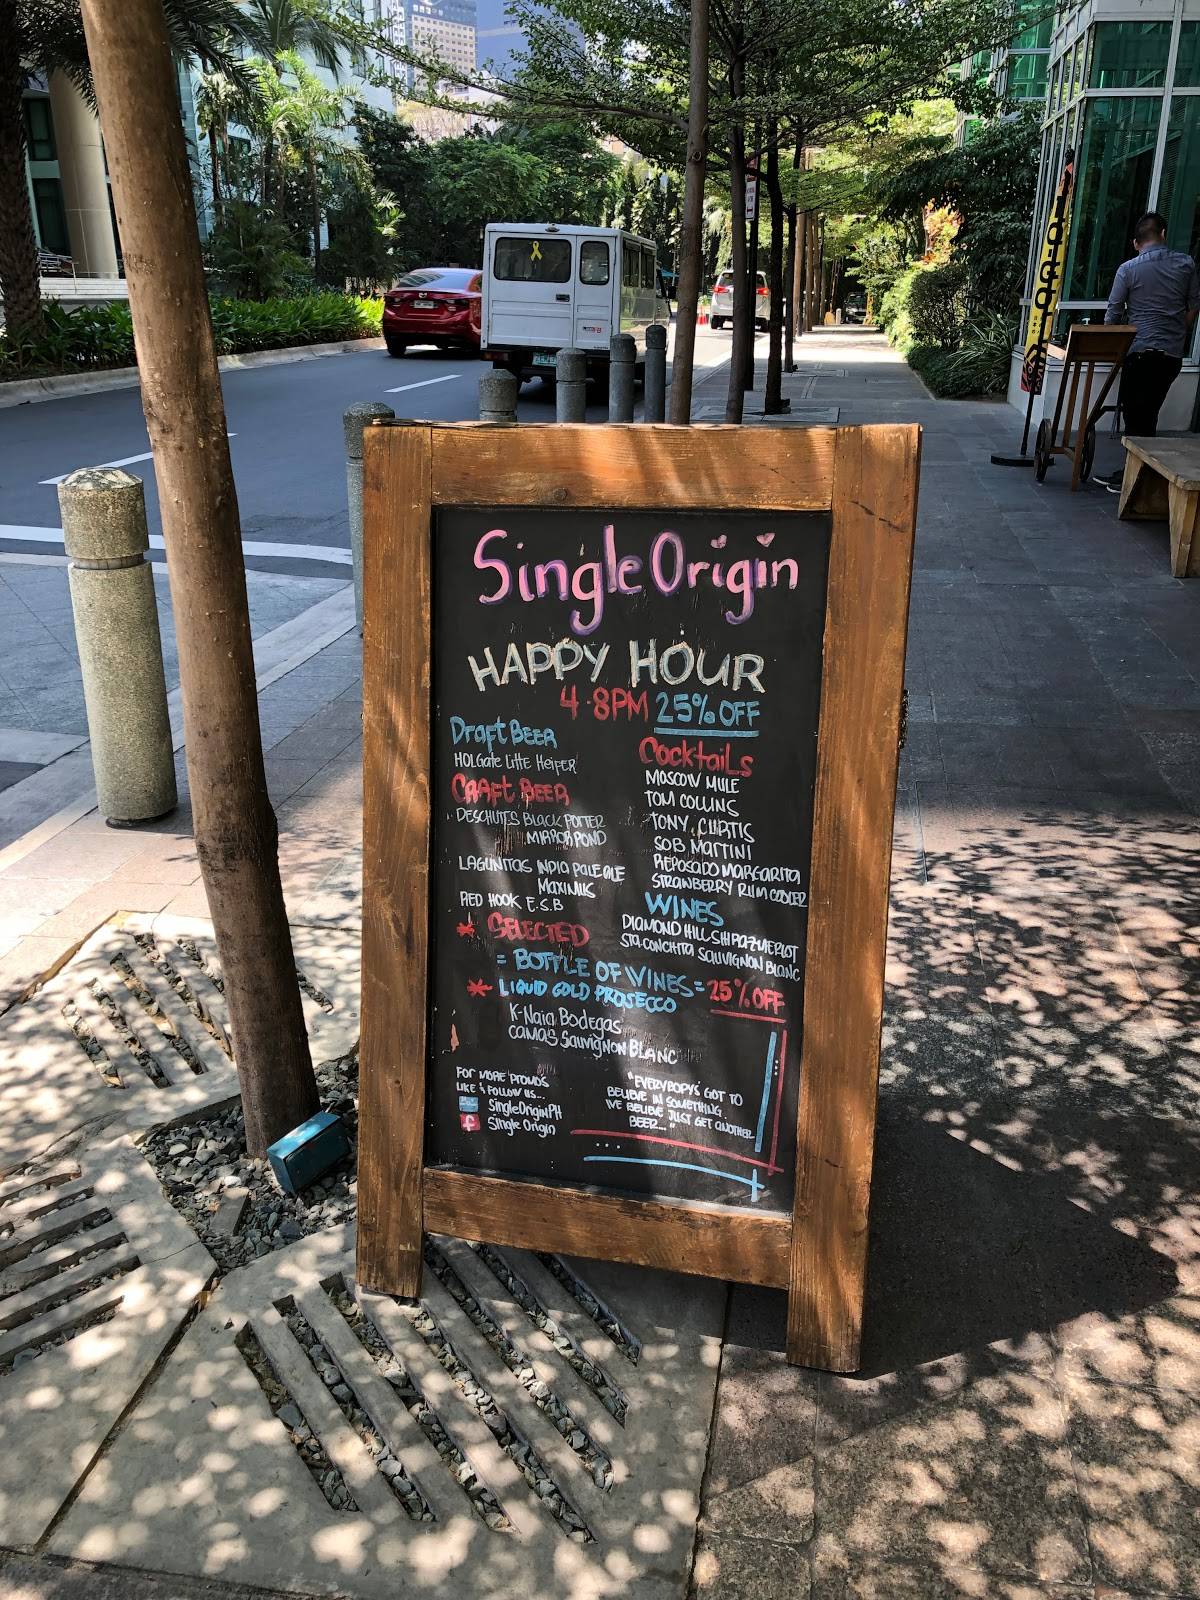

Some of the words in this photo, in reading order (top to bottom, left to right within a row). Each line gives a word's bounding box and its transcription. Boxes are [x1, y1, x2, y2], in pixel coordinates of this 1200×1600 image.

[473, 524, 643, 635] Single
[652, 530, 799, 625] Origin
[467, 636, 610, 692] HAPPY
[629, 638, 766, 693] HOUR
[655, 692, 716, 725] 25%
[718, 700, 761, 727] OFF
[706, 776, 740, 794] MULE
[644, 790, 676, 807] TOM
[573, 829, 607, 848] POND
[650, 811, 689, 832] TONY
[698, 817, 755, 843] CURTIS
[653, 835, 686, 853] SOB
[460, 891, 484, 908] RED
[487, 892, 523, 910] HOOK
[737, 882, 768, 901] RUM
[644, 891, 724, 927] WINES
[487, 911, 591, 948] SELECTED
[512, 947, 591, 978] BOTTLE
[595, 960, 622, 983] OF
[624, 965, 695, 998] WINES
[752, 986, 786, 1015] OFF
[498, 978, 548, 998] LIQUID
[551, 980, 591, 1001] GOLD
[594, 984, 678, 1014] PROSECCO
[628, 1037, 679, 1065] BLANC
[456, 1081, 476, 1093] LIKE
[486, 1084, 522, 1097] FOLLOW
[652, 1093, 663, 1106] IN
[703, 1087, 727, 1102] GOT
[729, 1093, 744, 1107] TO
[487, 1113, 521, 1137] Single
[522, 1118, 556, 1138] Origin
[605, 1099, 623, 1110] WE
[667, 1109, 692, 1126] JUST
[694, 1116, 713, 1130] GET
